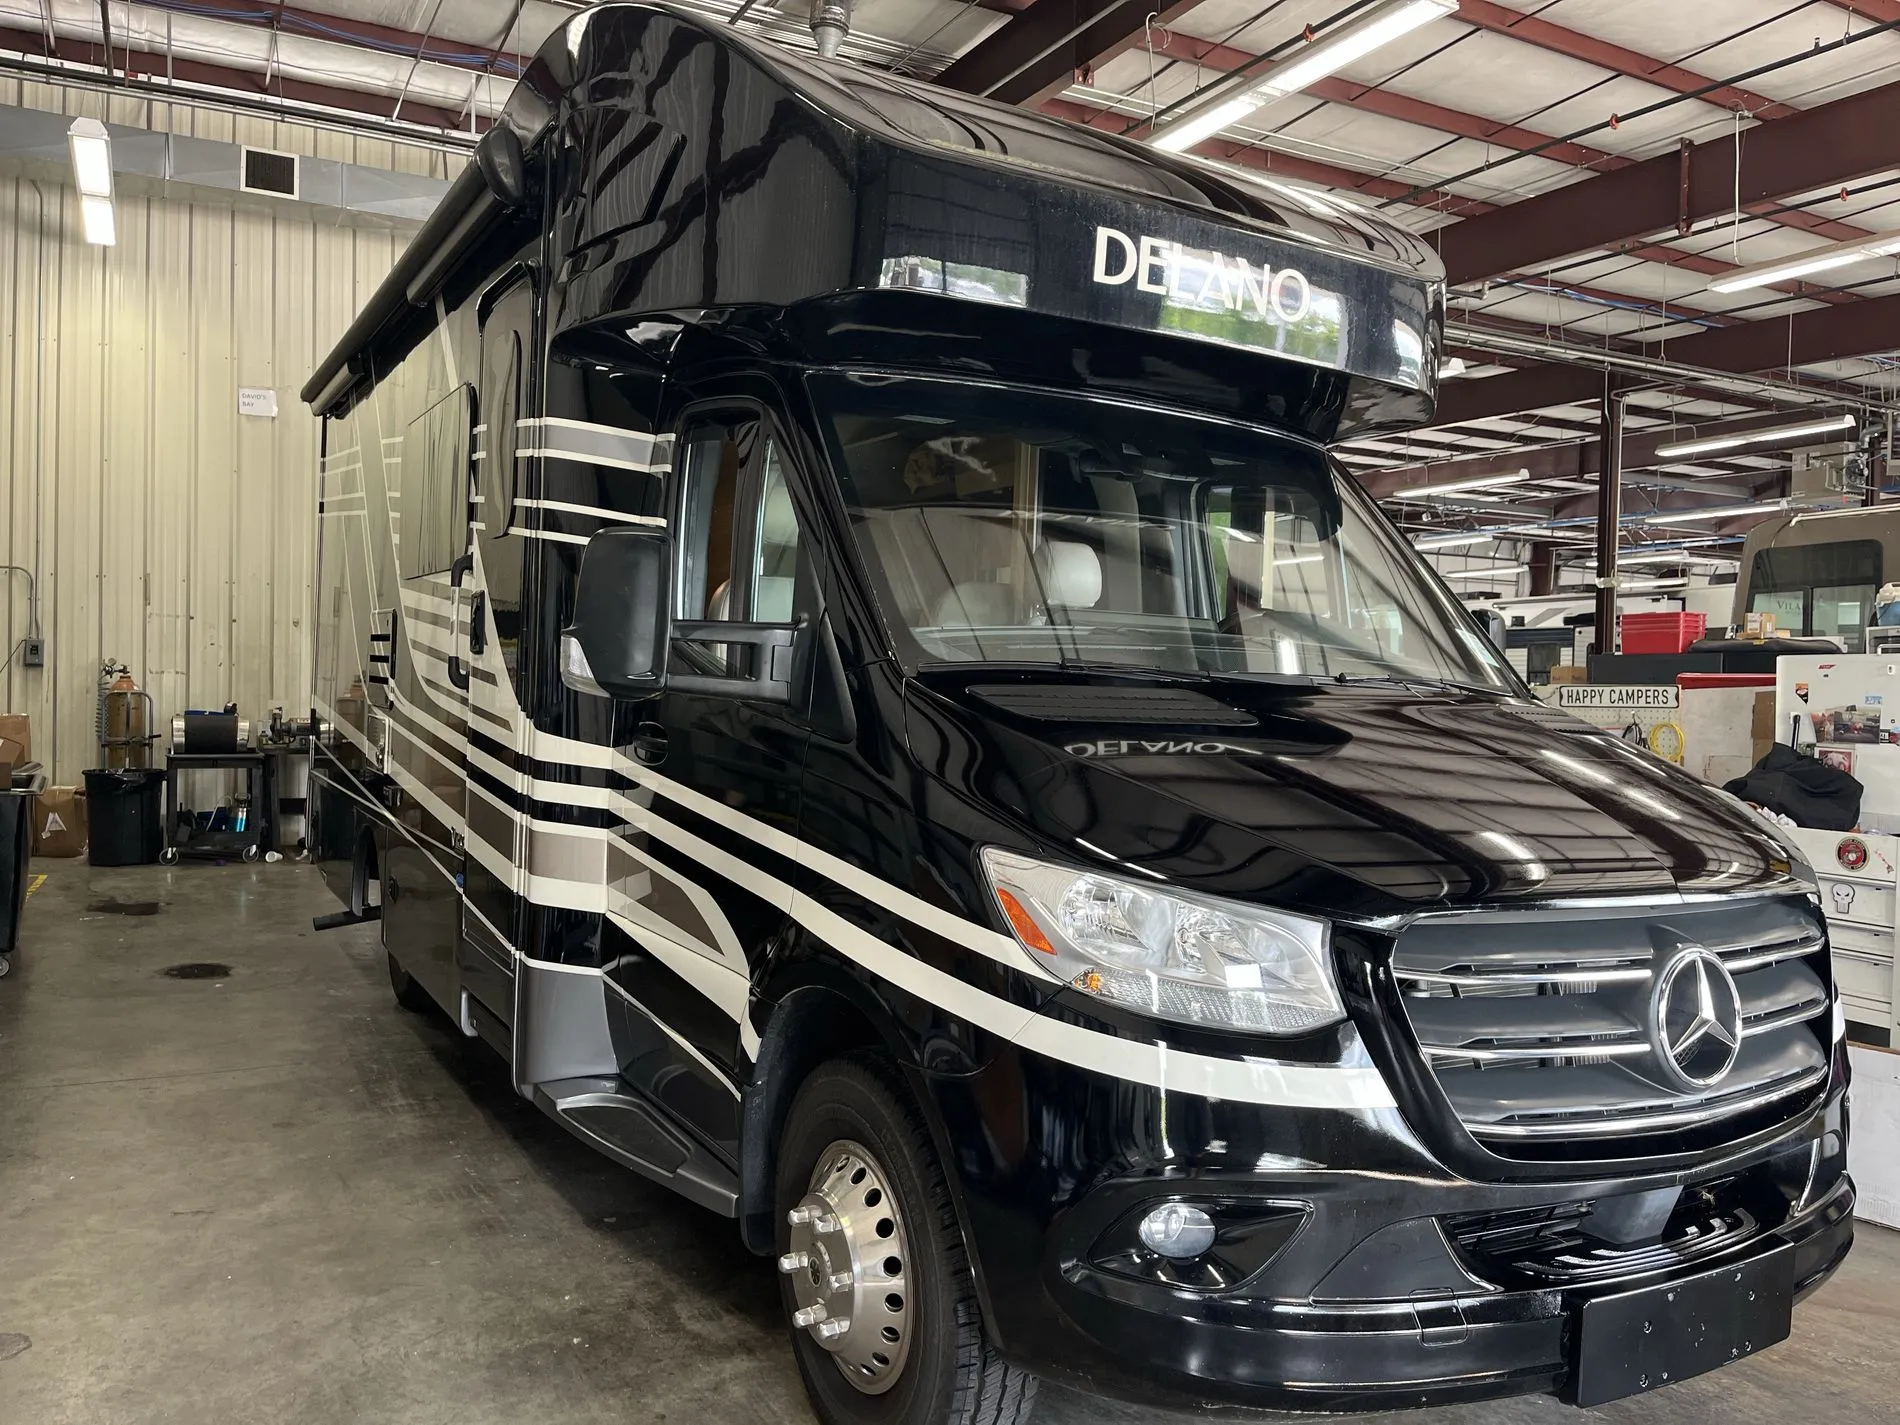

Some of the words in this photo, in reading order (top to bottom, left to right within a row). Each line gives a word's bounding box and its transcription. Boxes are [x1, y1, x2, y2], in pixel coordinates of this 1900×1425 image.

[1093, 226, 1311, 322] DELANO
[1567, 688, 1604, 704] HAPPY
[1609, 688, 1669, 705] CAMPERS
